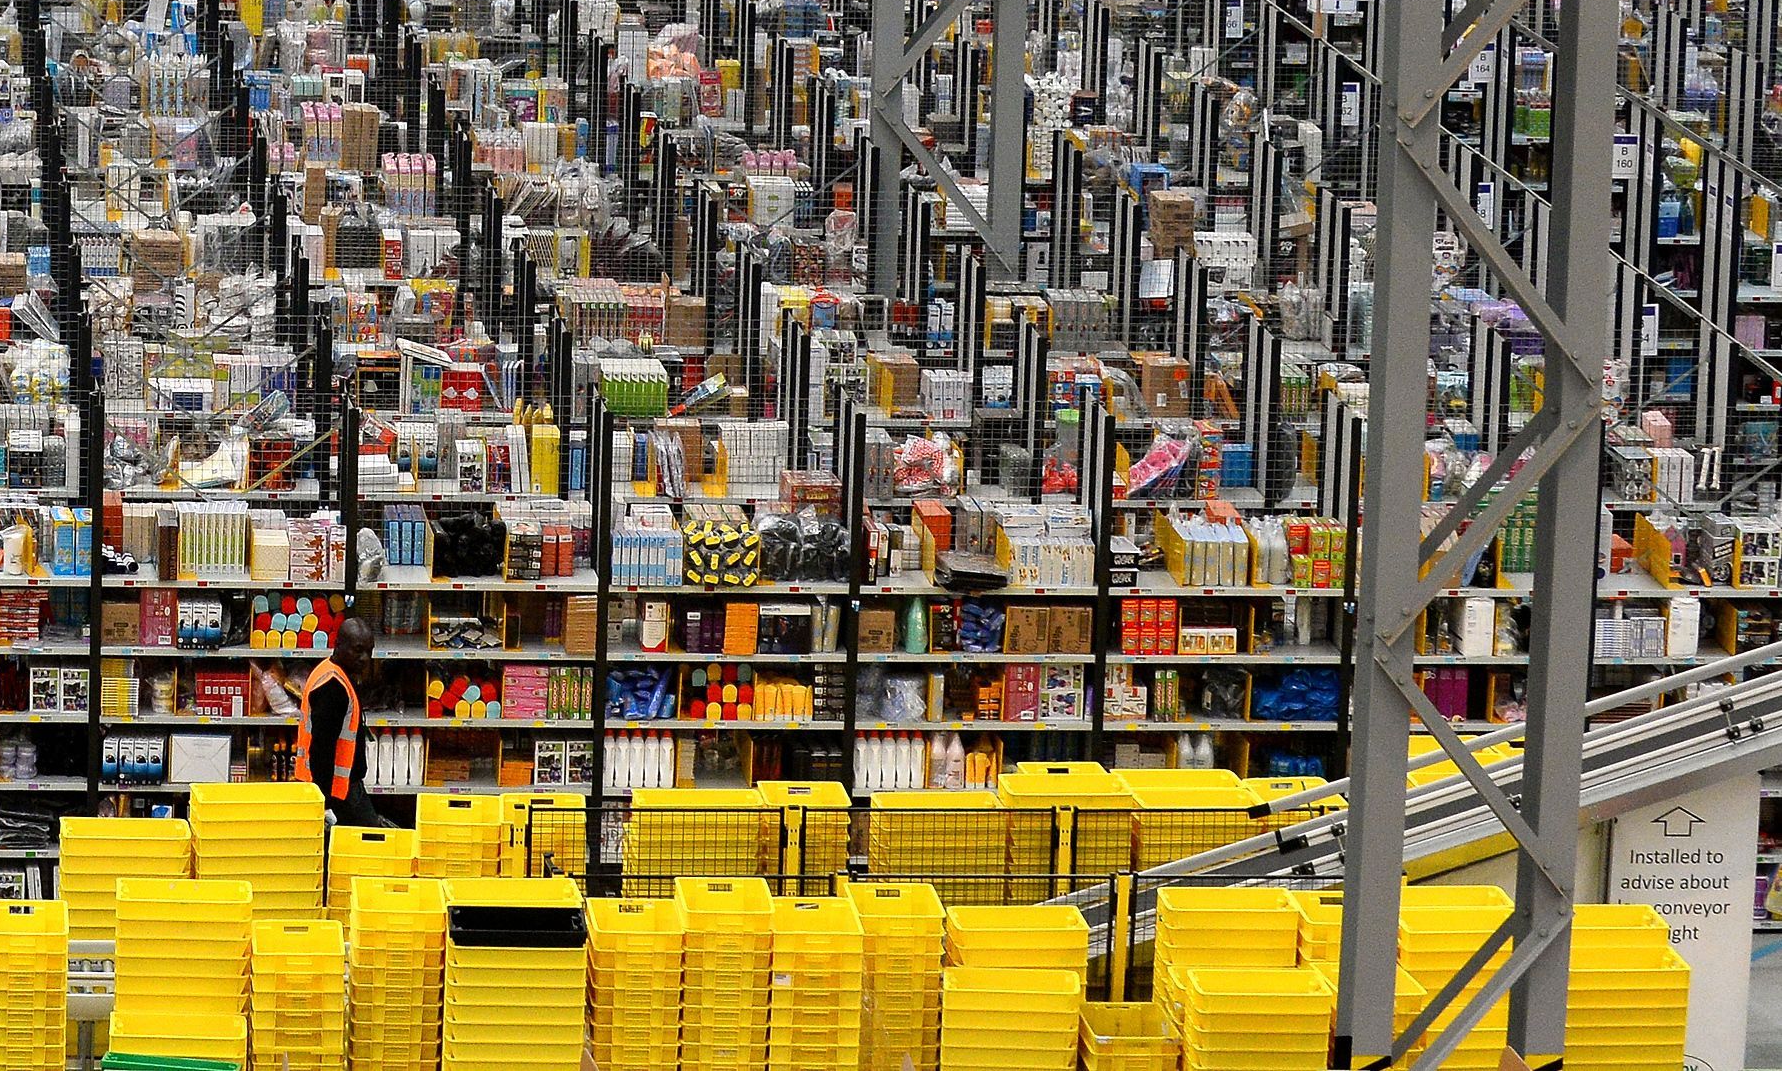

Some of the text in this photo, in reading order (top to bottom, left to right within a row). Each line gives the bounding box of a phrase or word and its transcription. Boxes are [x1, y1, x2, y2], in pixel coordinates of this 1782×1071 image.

[1480, 53, 1486, 61] B
[1475, 64, 1490, 73] 164
[1621, 146, 1628, 155] B
[1617, 159, 1633, 168] 160
[1630, 848, 1724, 864] Installed to
[1620, 875, 1730, 890] advise about
[1654, 901, 1730, 918] conveyor
[1667, 924, 1699, 944] ight
